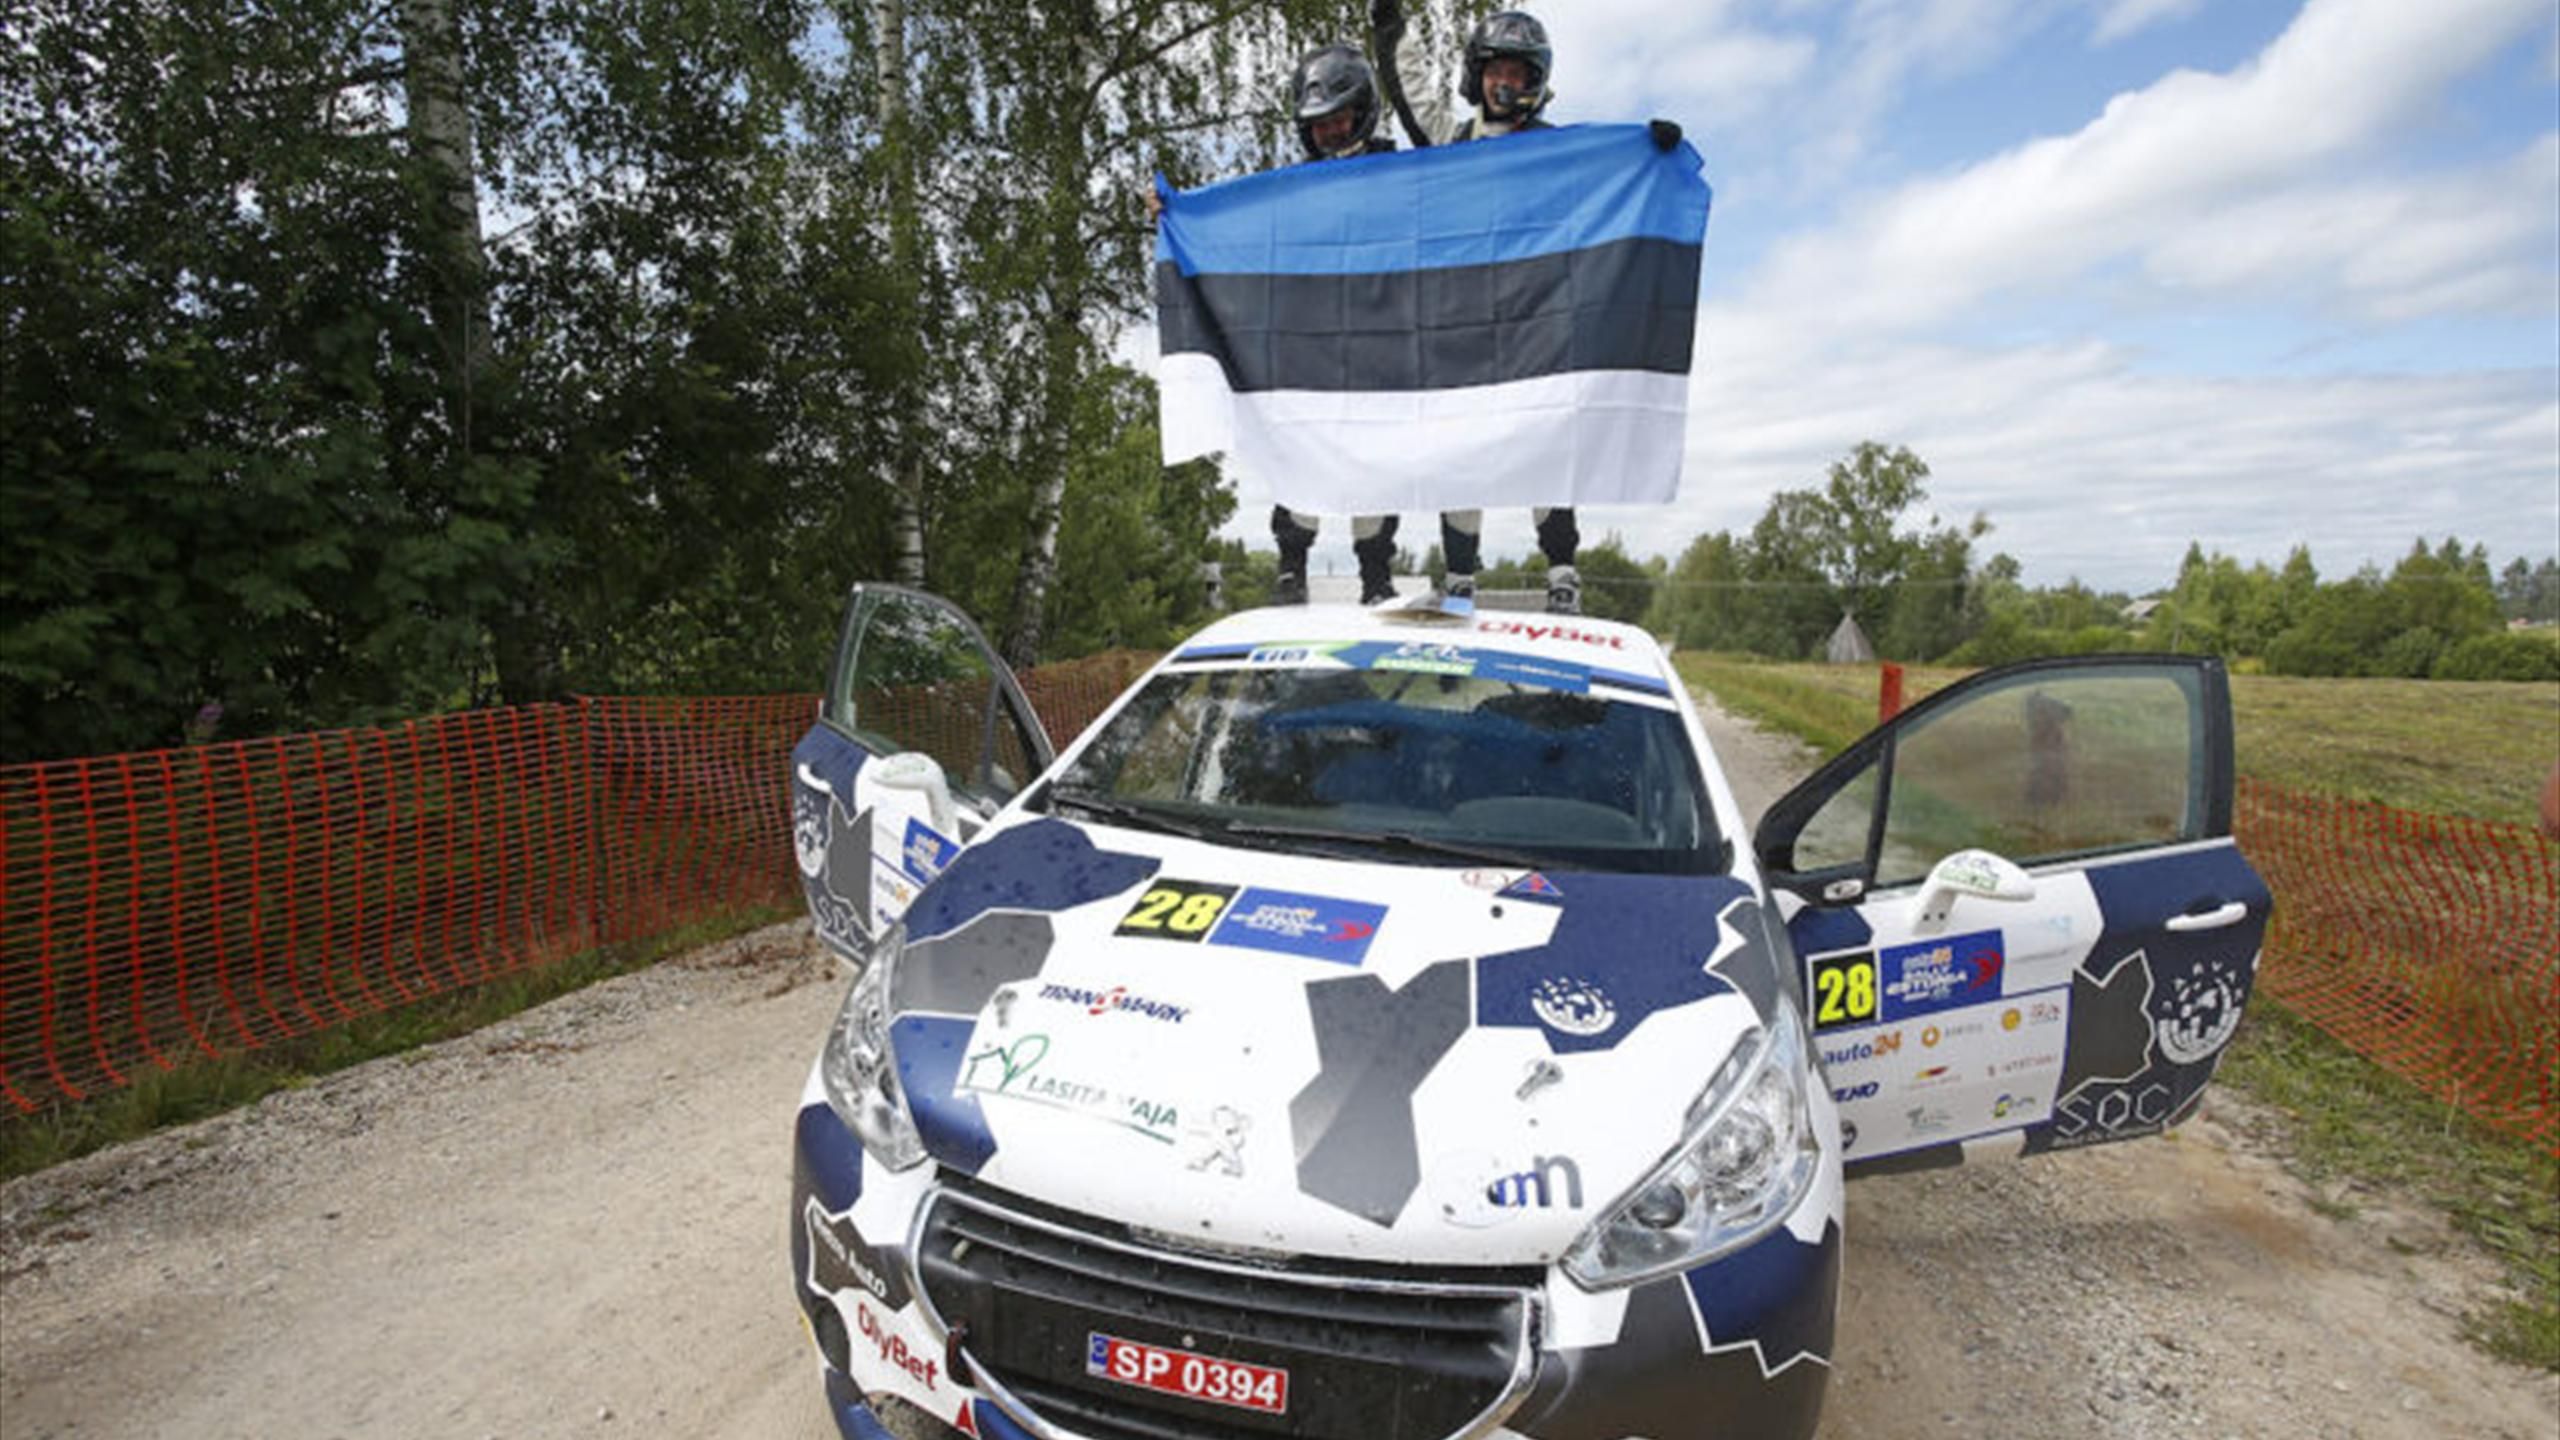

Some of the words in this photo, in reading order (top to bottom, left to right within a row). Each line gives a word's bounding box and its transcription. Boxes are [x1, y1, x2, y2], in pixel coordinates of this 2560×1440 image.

[1121, 889, 1225, 932] 28
[1817, 963, 1875, 1023] 28
[1823, 1030, 1901, 1065] auto24
[1121, 1097, 1178, 1127] AJA
[1114, 1346, 1170, 1382] SP
[1182, 1360, 1279, 1406] 0394
